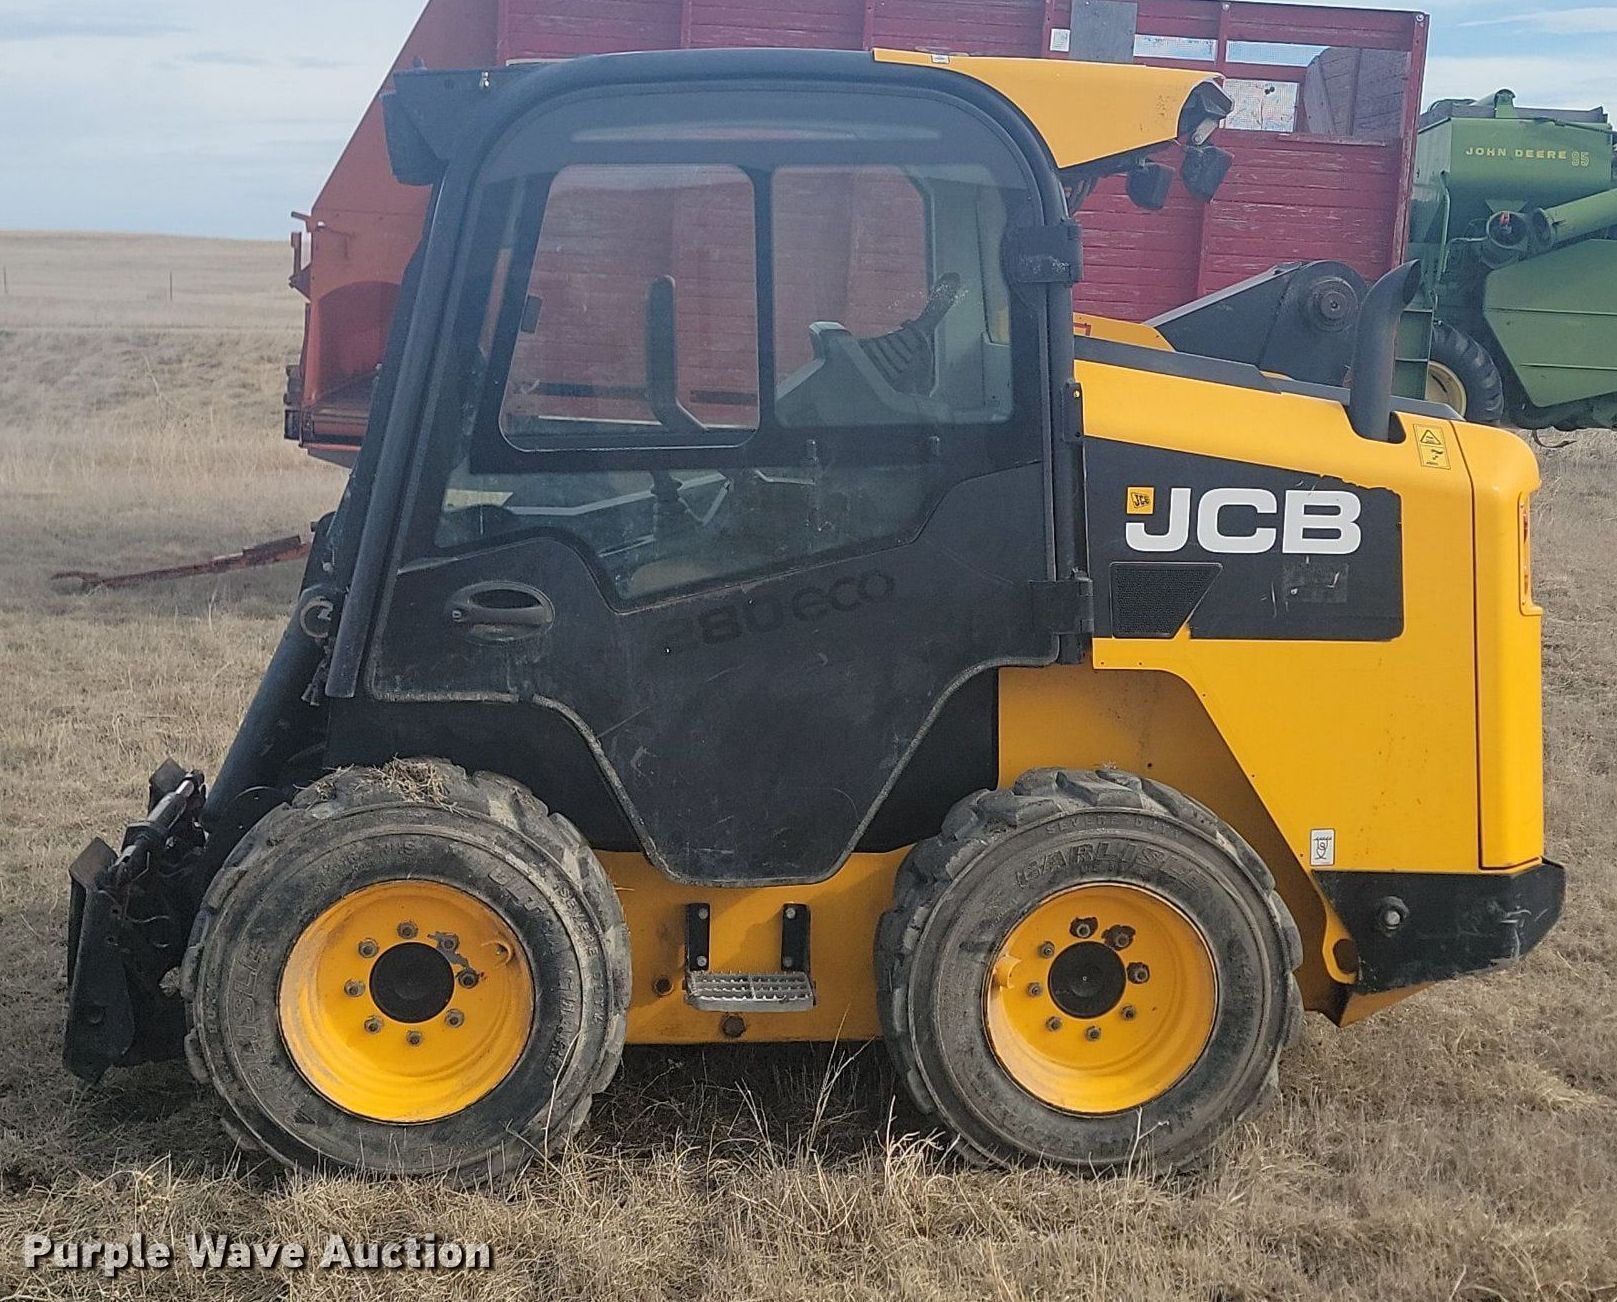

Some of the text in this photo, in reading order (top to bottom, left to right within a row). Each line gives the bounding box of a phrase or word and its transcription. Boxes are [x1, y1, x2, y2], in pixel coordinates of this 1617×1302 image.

[1466, 147, 1507, 157] JOHN
[1515, 149, 1567, 159] DEERE
[1126, 487, 1362, 554] JCB
